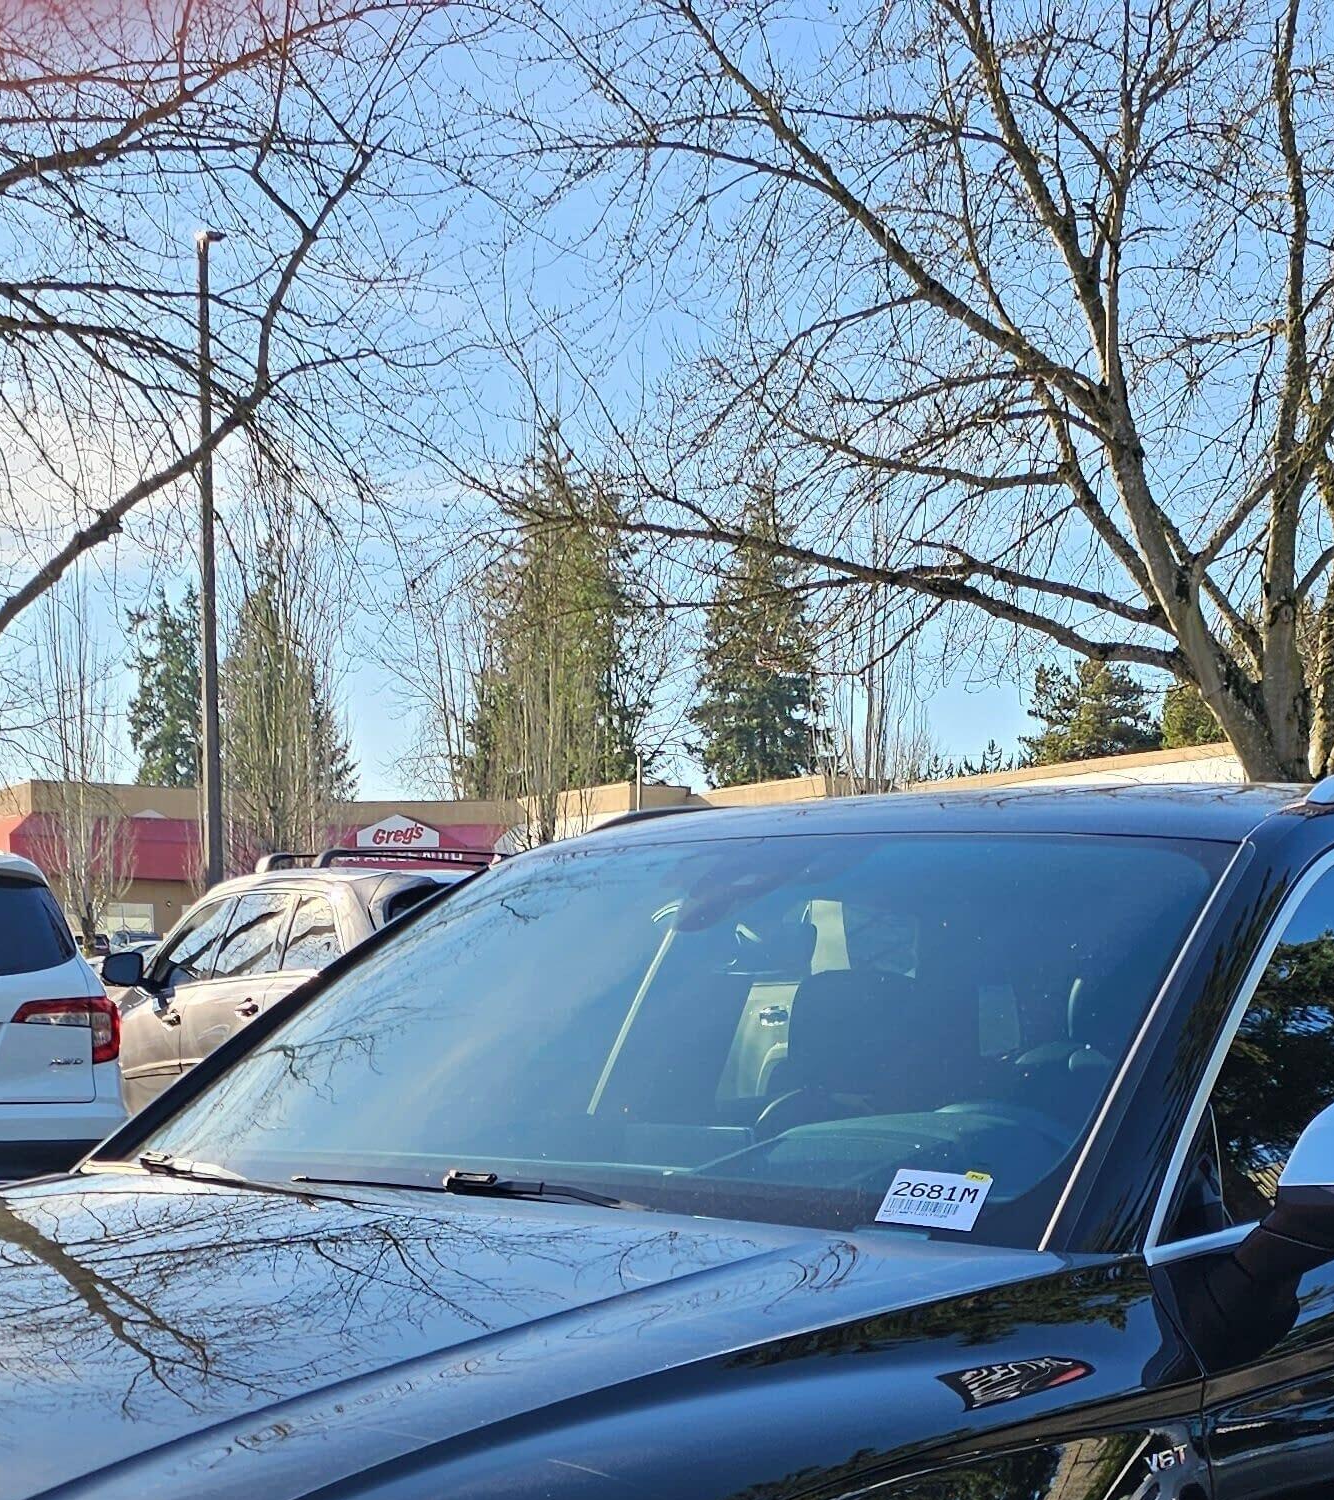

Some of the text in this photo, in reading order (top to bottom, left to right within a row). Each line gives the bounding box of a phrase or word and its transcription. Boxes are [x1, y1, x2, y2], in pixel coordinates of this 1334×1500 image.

[372, 824, 424, 845] Greg's
[891, 1181, 980, 1204] 2681M
[1144, 1444, 1188, 1472] V6T
